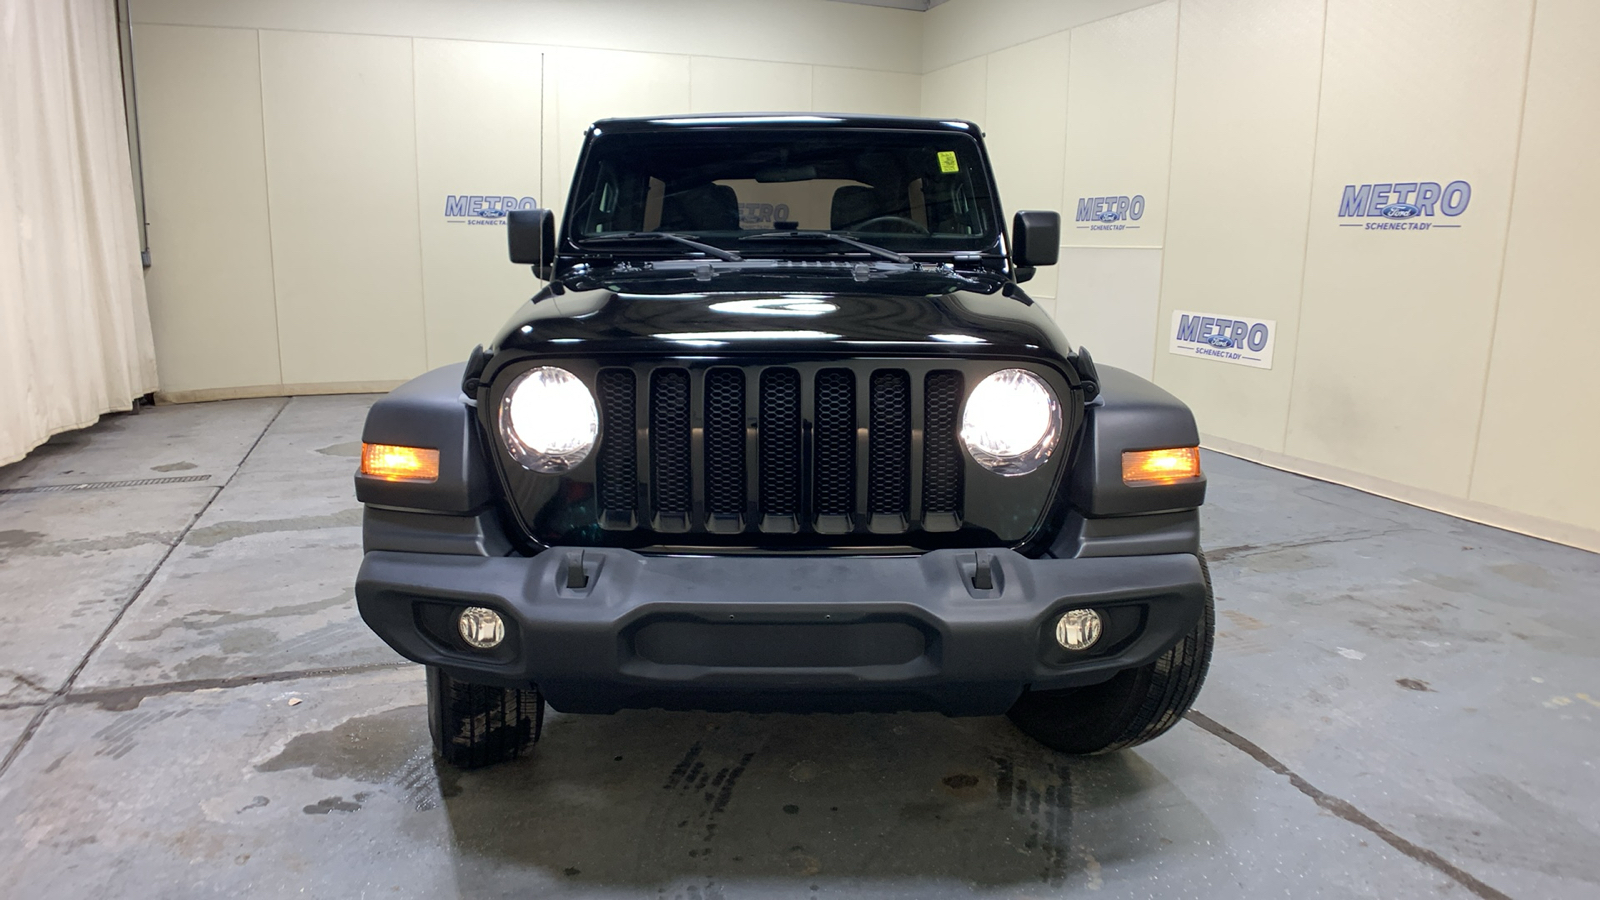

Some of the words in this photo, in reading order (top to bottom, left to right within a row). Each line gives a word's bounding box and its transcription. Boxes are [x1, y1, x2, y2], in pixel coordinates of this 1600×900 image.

[444, 195, 537, 217] METRO
[1075, 194, 1146, 222] METRO
[1338, 180, 1472, 217] METRO
[737, 202, 790, 223] ETRO
[1386, 206, 1412, 217] Ford
[1365, 222, 1432, 230] SCHENECTADY
[1176, 314, 1269, 352] METRO
[1195, 347, 1242, 360] SCHENECTADY
